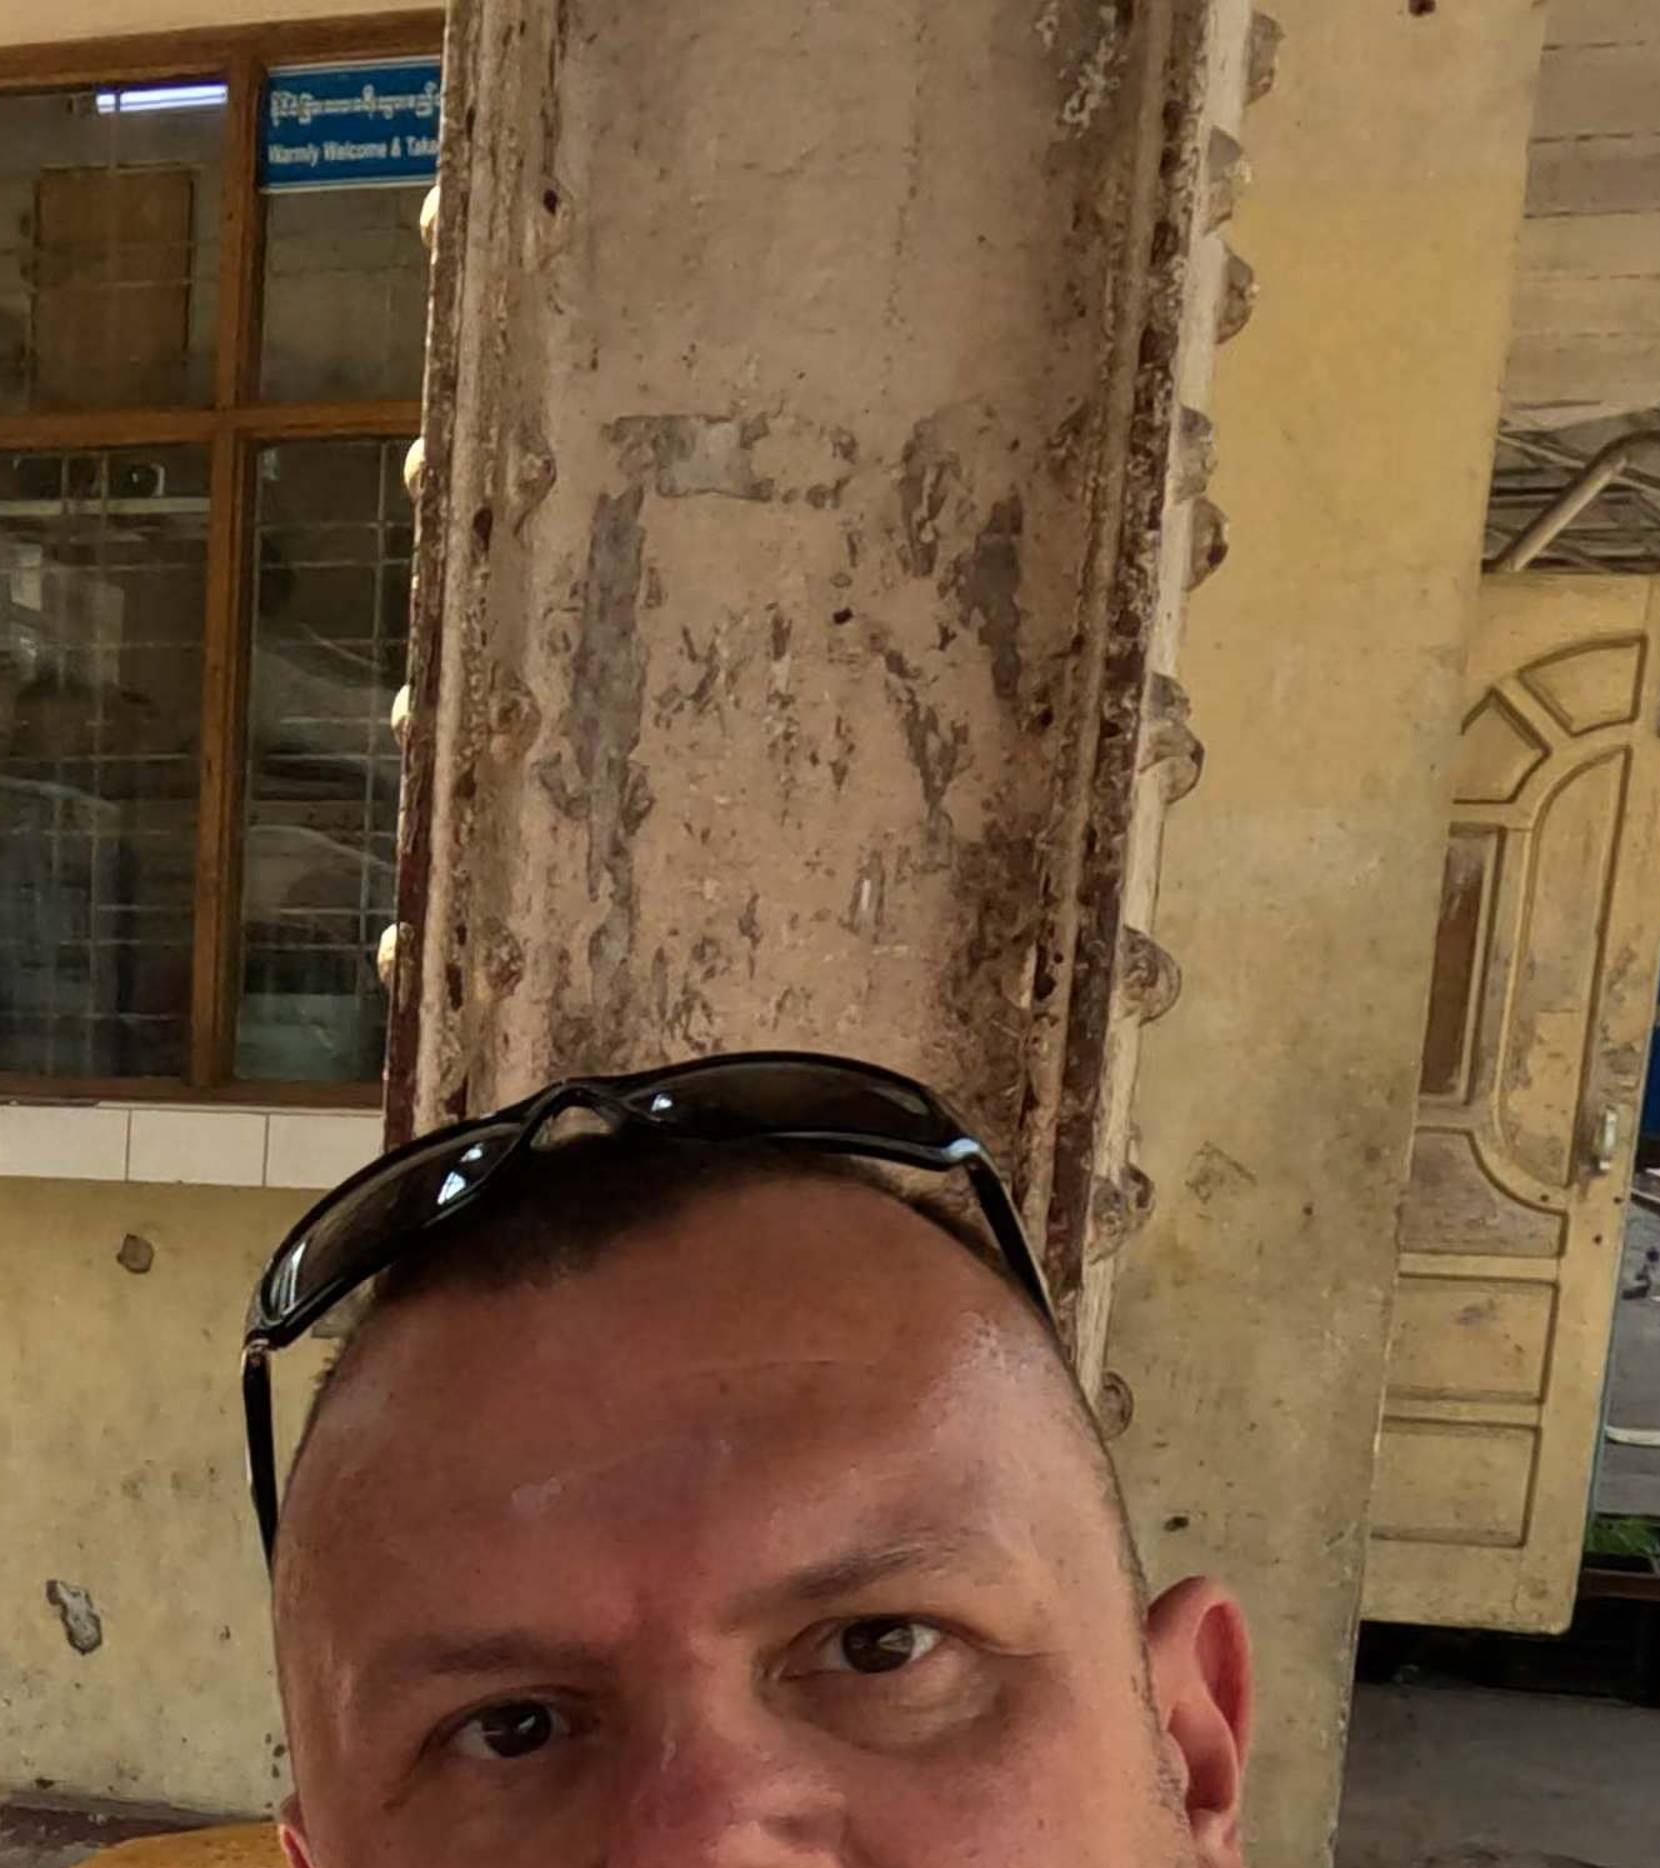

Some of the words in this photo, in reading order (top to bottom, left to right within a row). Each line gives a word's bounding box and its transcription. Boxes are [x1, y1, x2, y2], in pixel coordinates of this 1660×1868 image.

[268, 143, 318, 167] Warmly
[323, 140, 387, 160] Welcome
[391, 136, 401, 157] &
